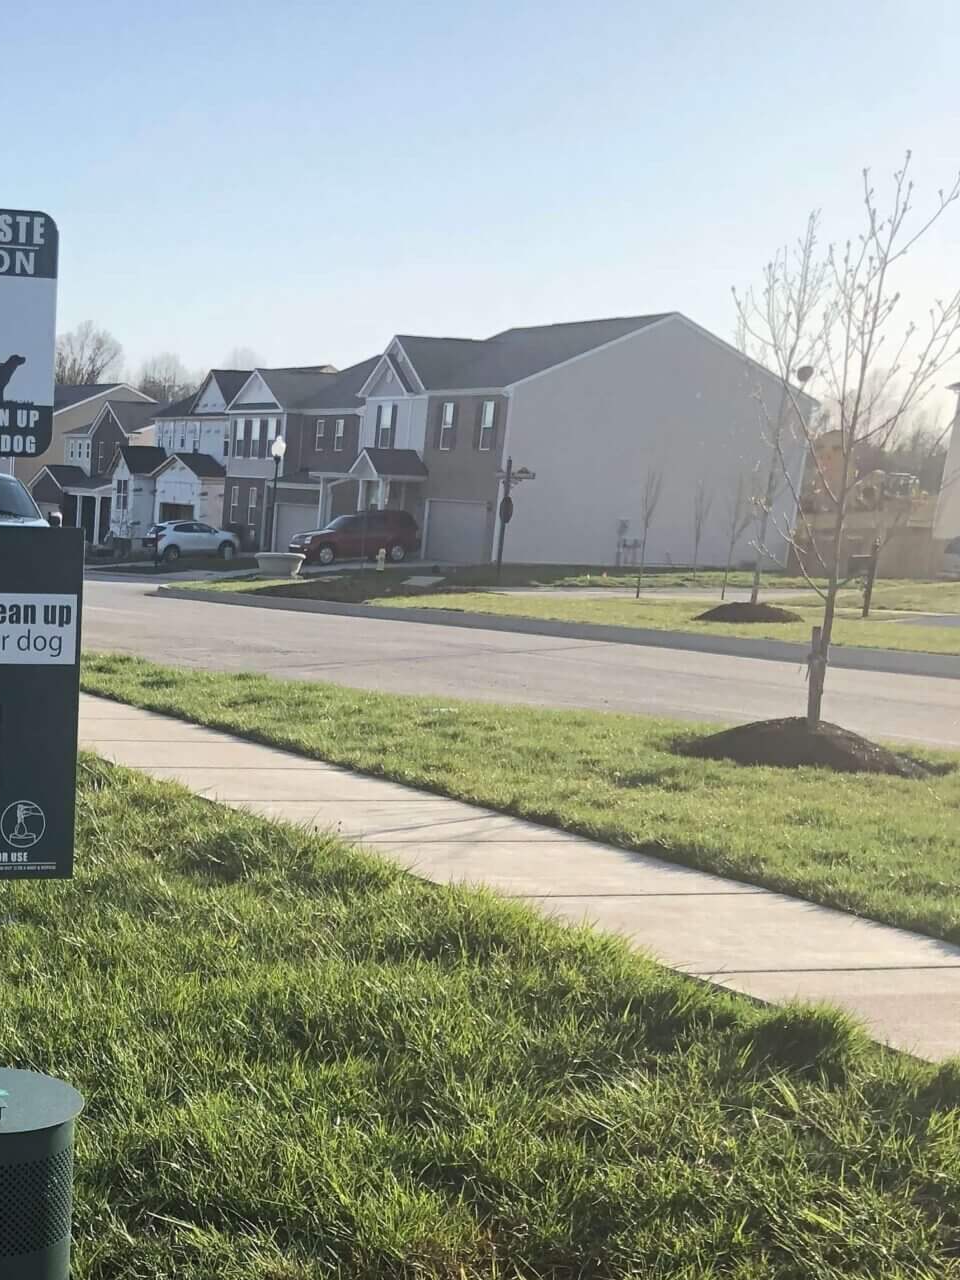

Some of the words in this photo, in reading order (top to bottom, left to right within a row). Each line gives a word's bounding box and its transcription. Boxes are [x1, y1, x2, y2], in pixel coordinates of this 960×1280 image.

[16, 409, 40, 428] UP
[0, 435, 37, 453] DOG
[43, 604, 72, 627] up
[17, 629, 62, 657] dog
[10, 851, 28, 862] USE
